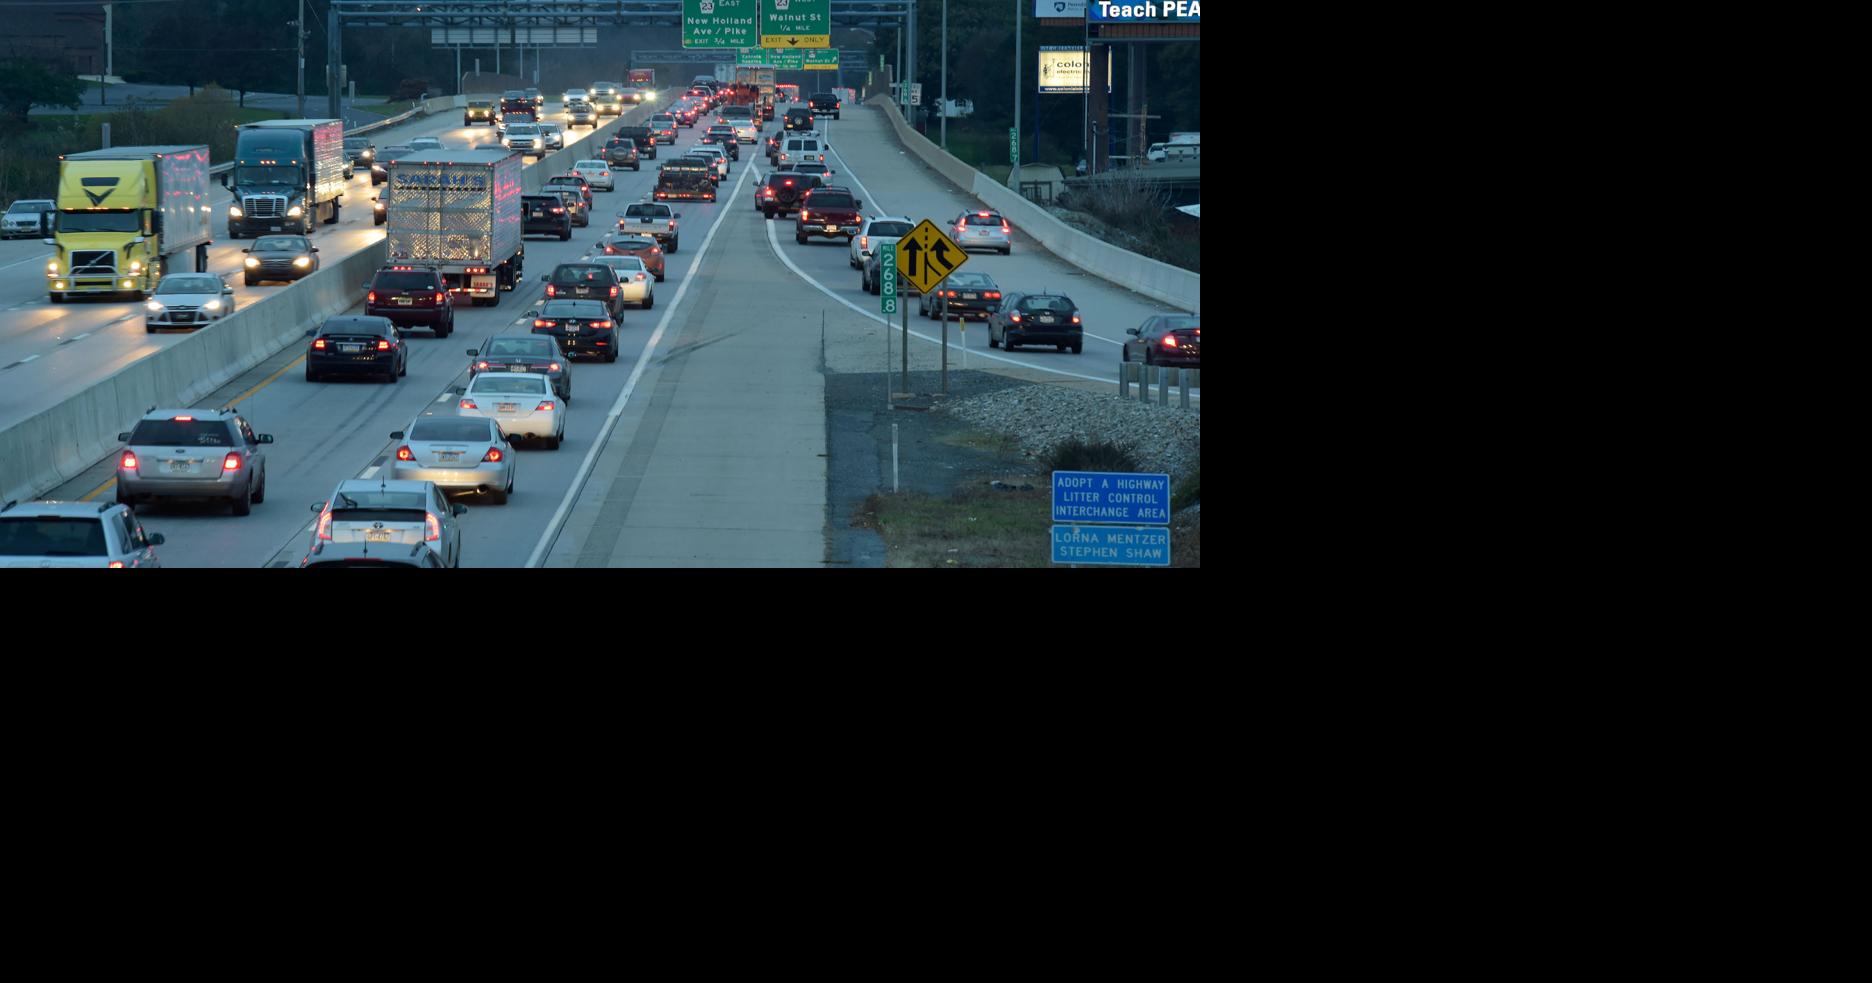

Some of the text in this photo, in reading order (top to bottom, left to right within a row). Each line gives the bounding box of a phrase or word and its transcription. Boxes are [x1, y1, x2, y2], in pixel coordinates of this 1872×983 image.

[702, 2, 713, 11] 23
[1098, 0, 1156, 18] Teach
[1162, 0, 1200, 18] PEA
[687, 17, 752, 25] New Holland
[1057, 477, 1165, 490] ADOPT A HIGHWAY
[1063, 491, 1158, 504] LITTER CONTROL
[1056, 505, 1166, 518] INTERCHANGE AREA
[1055, 532, 1166, 545] LORNA MENTZER
[1060, 546, 1162, 558] STEPHEN SHAW
